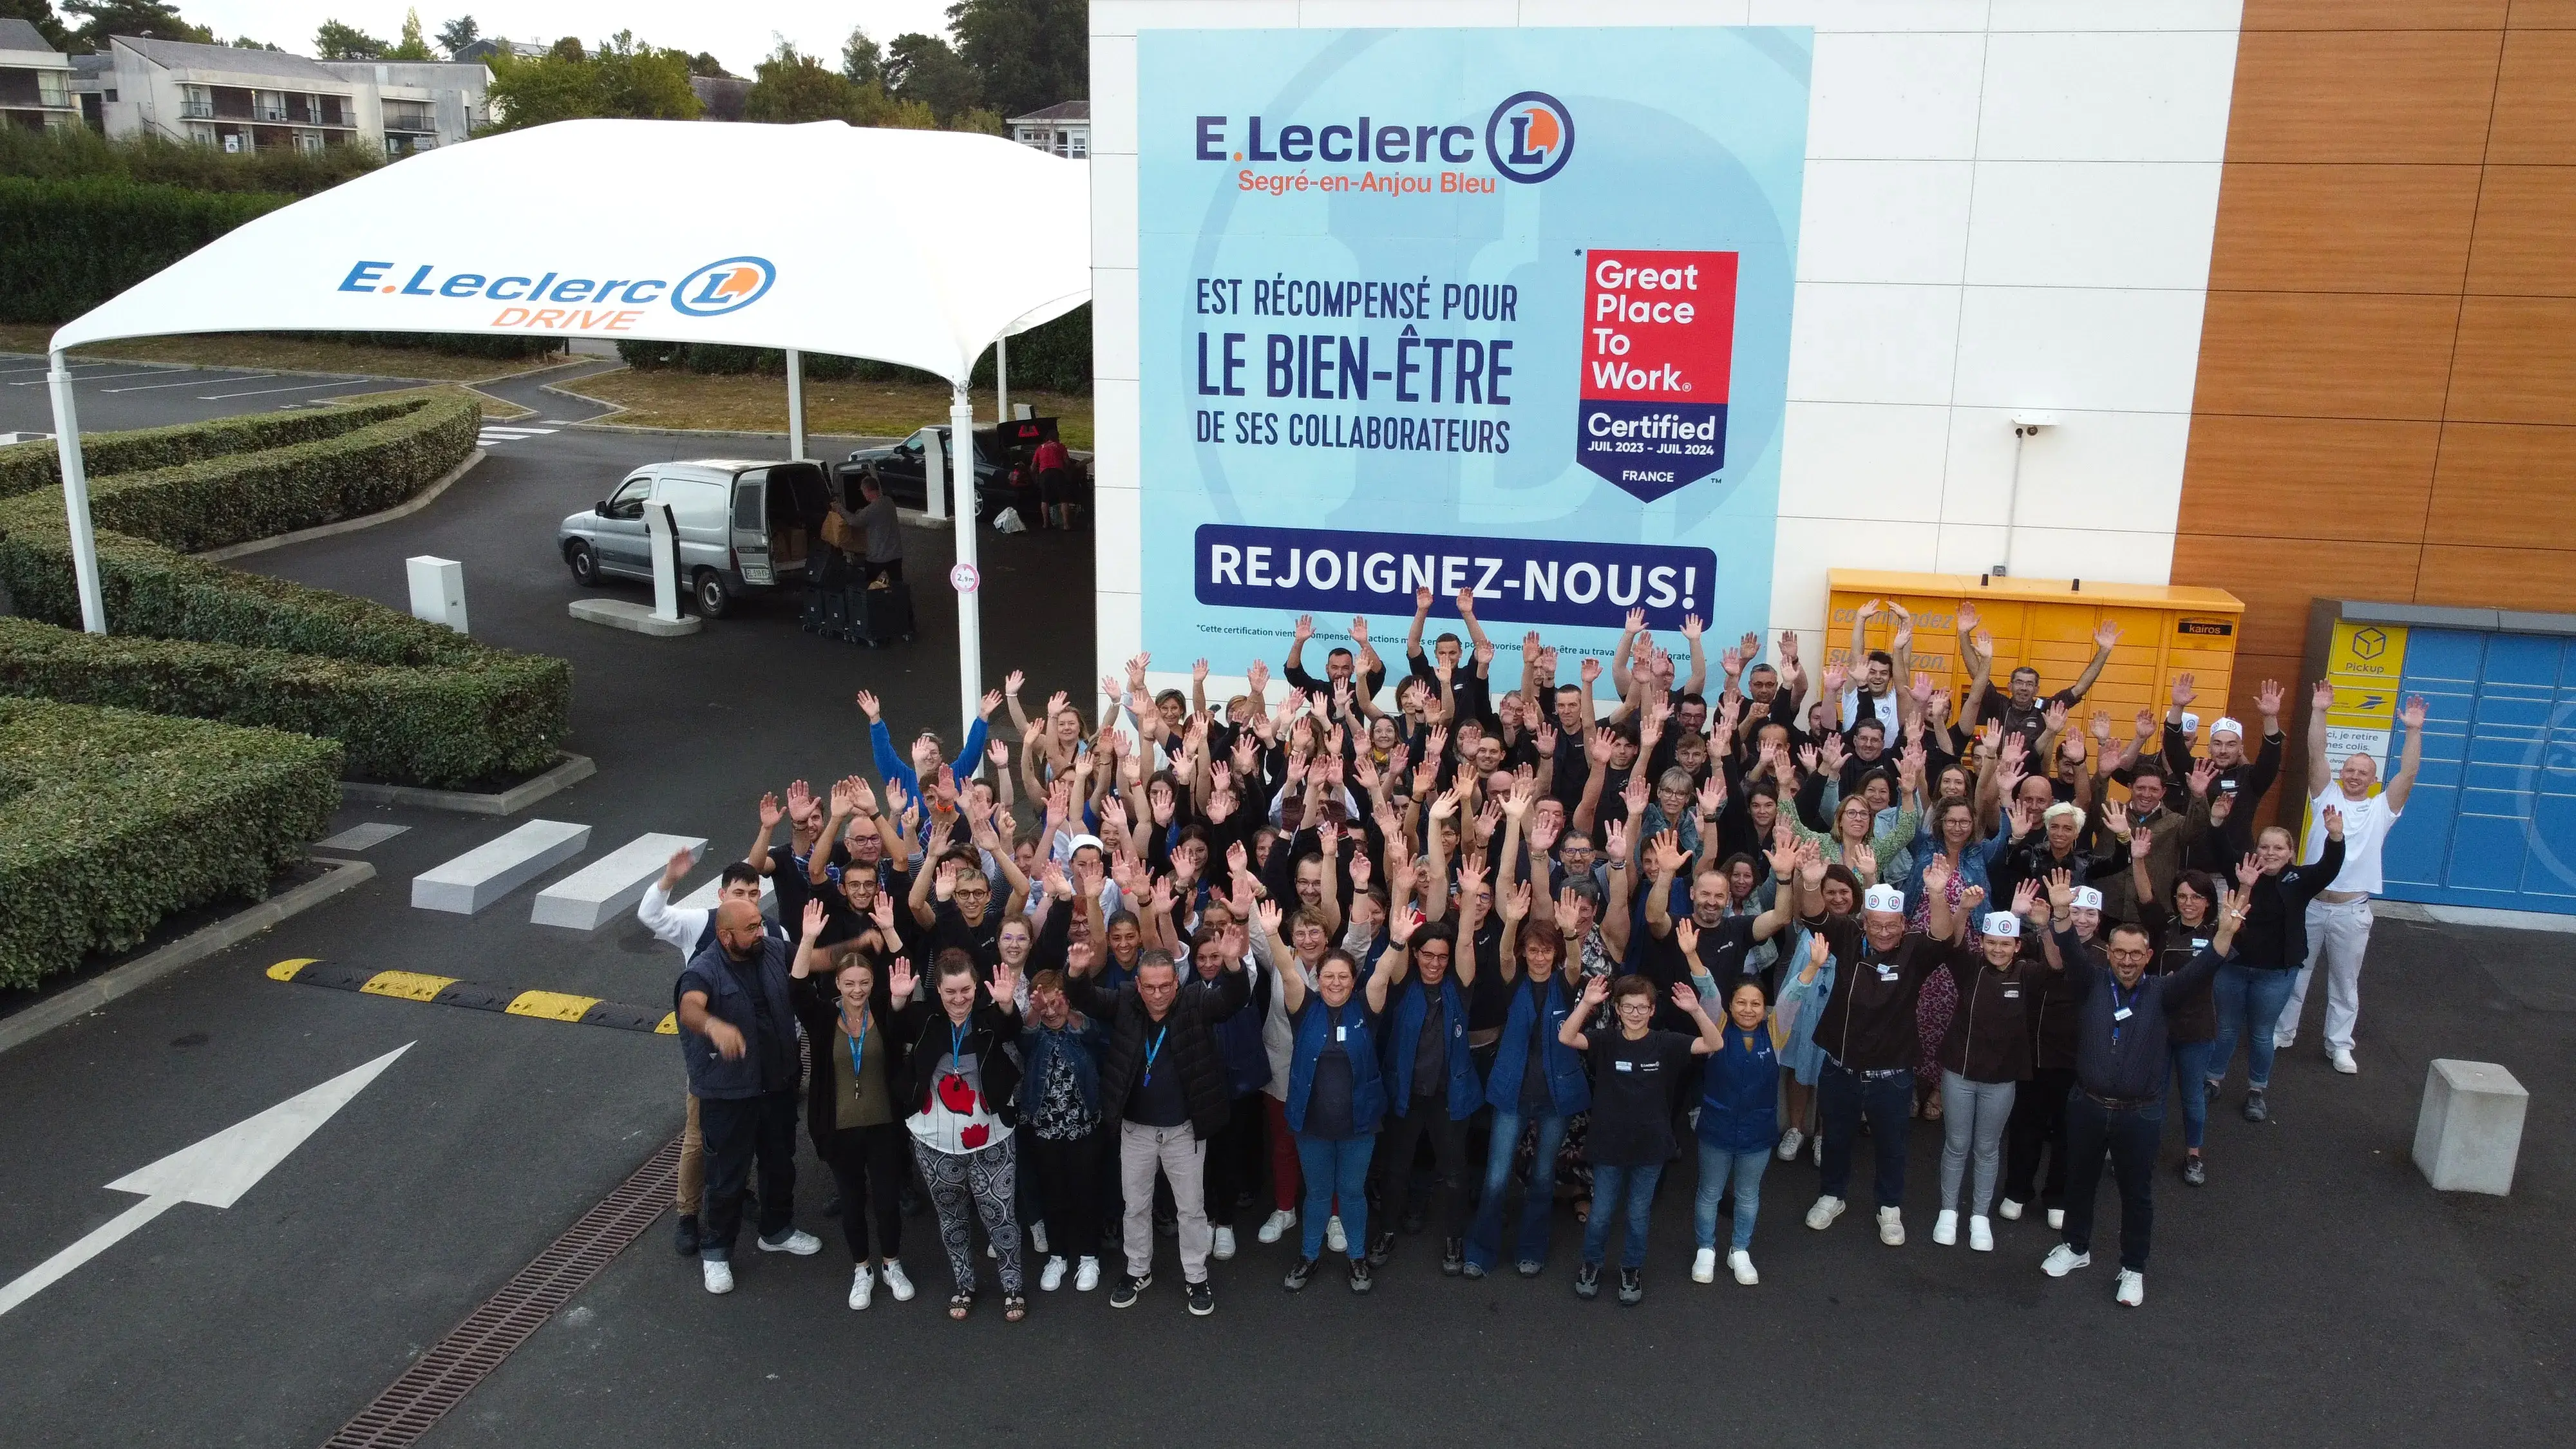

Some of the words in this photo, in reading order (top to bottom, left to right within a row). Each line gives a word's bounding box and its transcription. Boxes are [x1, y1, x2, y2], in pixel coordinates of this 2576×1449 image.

[1196, 115, 1474, 163] E.Leclerc
[1238, 169, 1432, 196] Segré-en-Anjou
[1440, 172, 1495, 193] Bleu
[337, 260, 667, 304] E.Leclerc
[1595, 260, 1698, 290] Great
[1197, 278, 1242, 315] EST
[1254, 272, 1430, 319] RÉCOMPENSÉ
[1443, 283, 1518, 322] POUR
[1596, 294, 1695, 325] Place
[490, 308, 645, 331] DRIVE
[1592, 328, 1631, 356] To
[1197, 332, 1245, 397] LE
[1267, 324, 1513, 406] BIEN-ÊTRE
[1197, 410, 1225, 443] DE
[1235, 412, 1278, 446] SES
[1289, 413, 1511, 454] COLLABORATEURS
[1587, 412, 1716, 440] Certified
[1587, 441, 1613, 452] JUIL
[1615, 442, 1643, 453] 2023
[1656, 443, 1682, 455] JUIL
[1685, 444, 1714, 455] 2024
[1622, 470, 1674, 482] FRANCE
[1211, 543, 1696, 611] REJOIGNEZ-NOUS!
[1224, 625, 1273, 637] certification
[1368, 634, 1399, 644] actions
[2189, 624, 2221, 634] kairos
[2345, 662, 2385, 674] Pickup
[2340, 731, 2349, 740] je
[2351, 733, 2378, 741] retire
[2345, 743, 2370, 751] colis.
